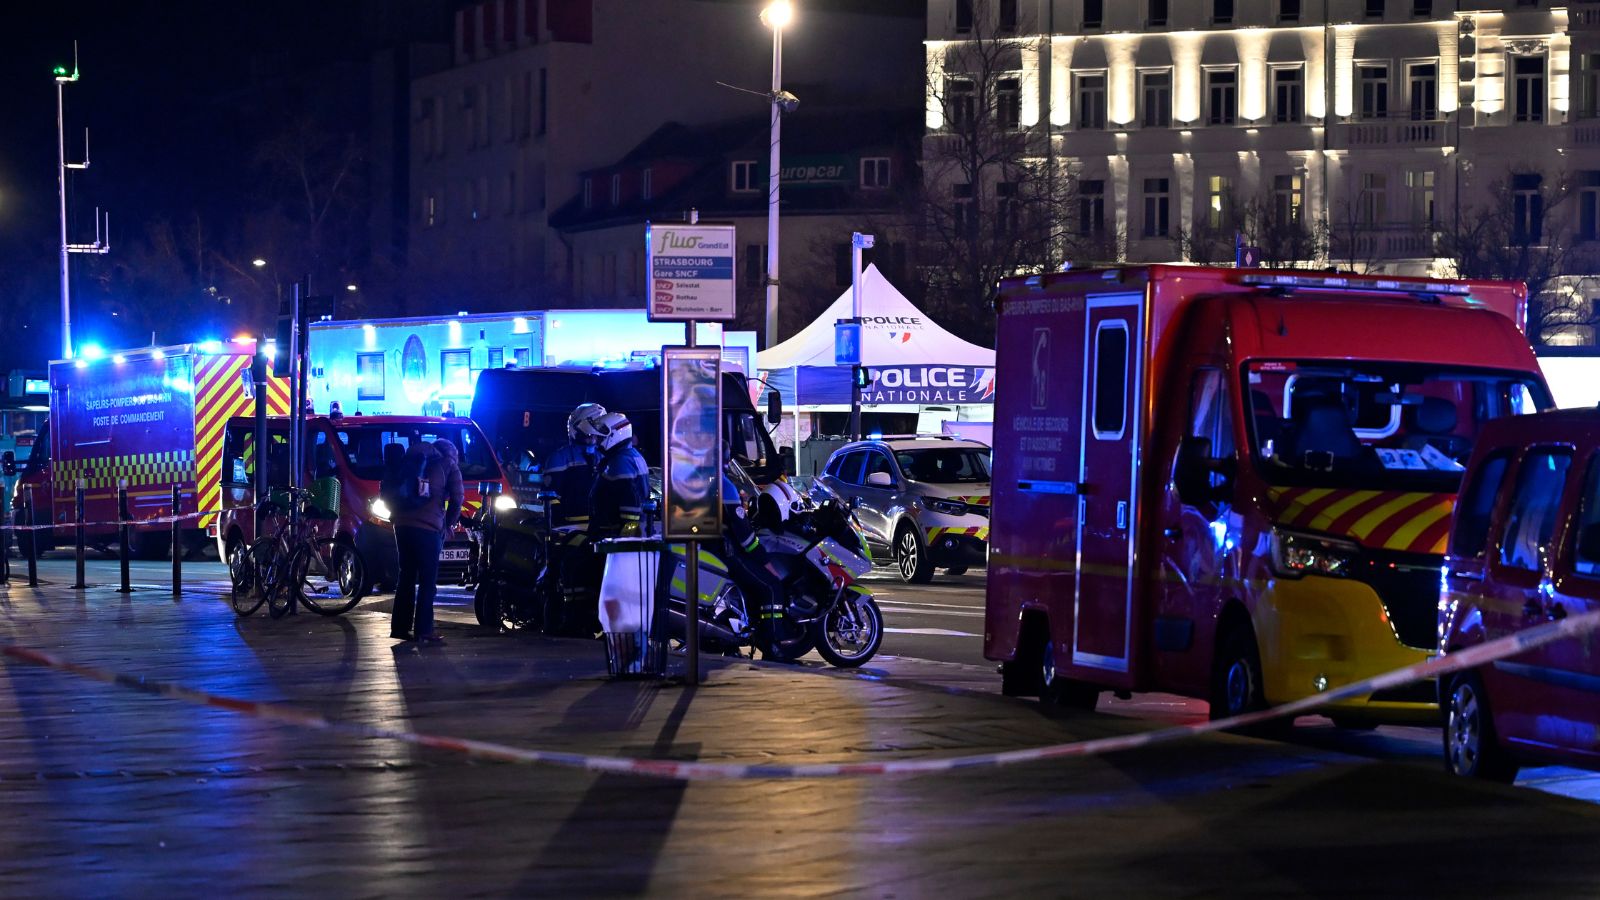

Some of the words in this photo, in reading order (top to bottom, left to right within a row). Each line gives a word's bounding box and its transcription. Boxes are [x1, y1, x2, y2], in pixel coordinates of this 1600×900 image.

[780, 165, 844, 181] uropcar
[657, 231, 703, 254] fluo
[862, 316, 922, 325] POLICE
[861, 390, 967, 401] NATIONALE
[93, 416, 110, 427] POSTE
[111, 415, 119, 425] DE
[120, 410, 165, 424] COMMANDEMENT
[523, 411, 530, 427] B
